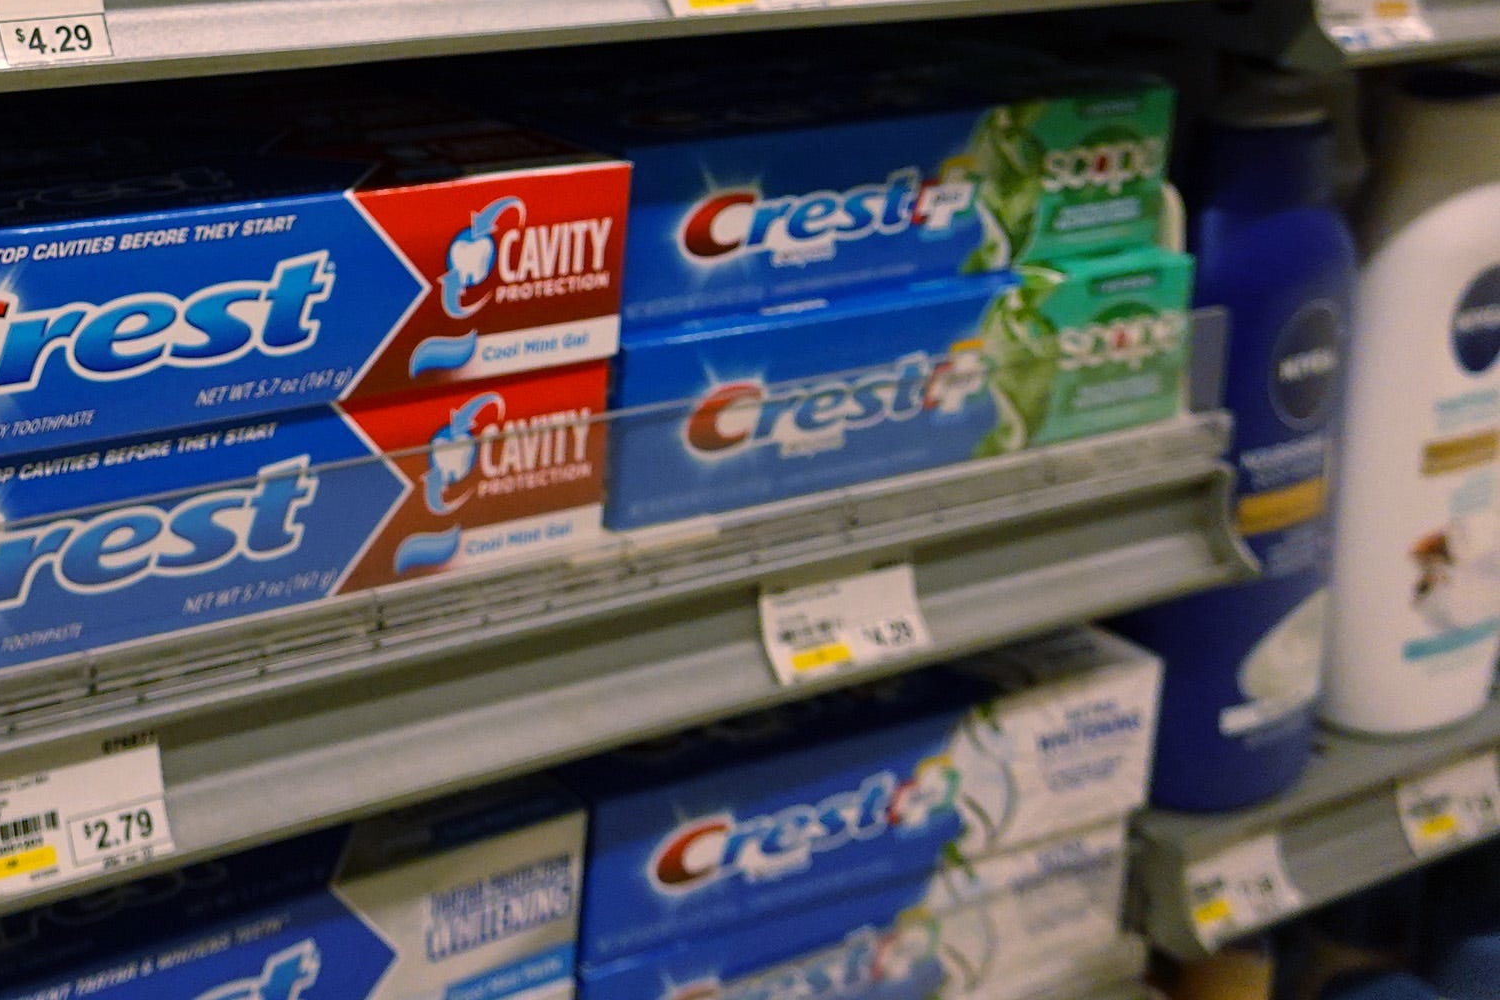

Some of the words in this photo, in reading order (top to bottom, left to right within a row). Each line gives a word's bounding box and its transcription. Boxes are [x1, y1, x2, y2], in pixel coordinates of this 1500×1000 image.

[15, 24, 93, 55] $4.29
[33, 235, 116, 261] CAVITIES
[119, 227, 189, 252] BEFORE
[193, 220, 240, 243] THEY
[241, 213, 297, 236] START
[681, 164, 923, 260] Crest
[498, 216, 613, 284] CAVITY
[495, 271, 612, 304] PROTECTION
[11, 408, 96, 438] TOOTHPASTE
[684, 354, 930, 453] Crest
[19, 453, 100, 481] CAVITIES
[103, 442, 171, 466] BEFORE
[176, 430, 220, 455] THEY
[223, 421, 278, 446] START
[479, 406, 593, 479] CAVITY
[84, 808, 154, 851] $2.79
[650, 770, 900, 888] Crest
